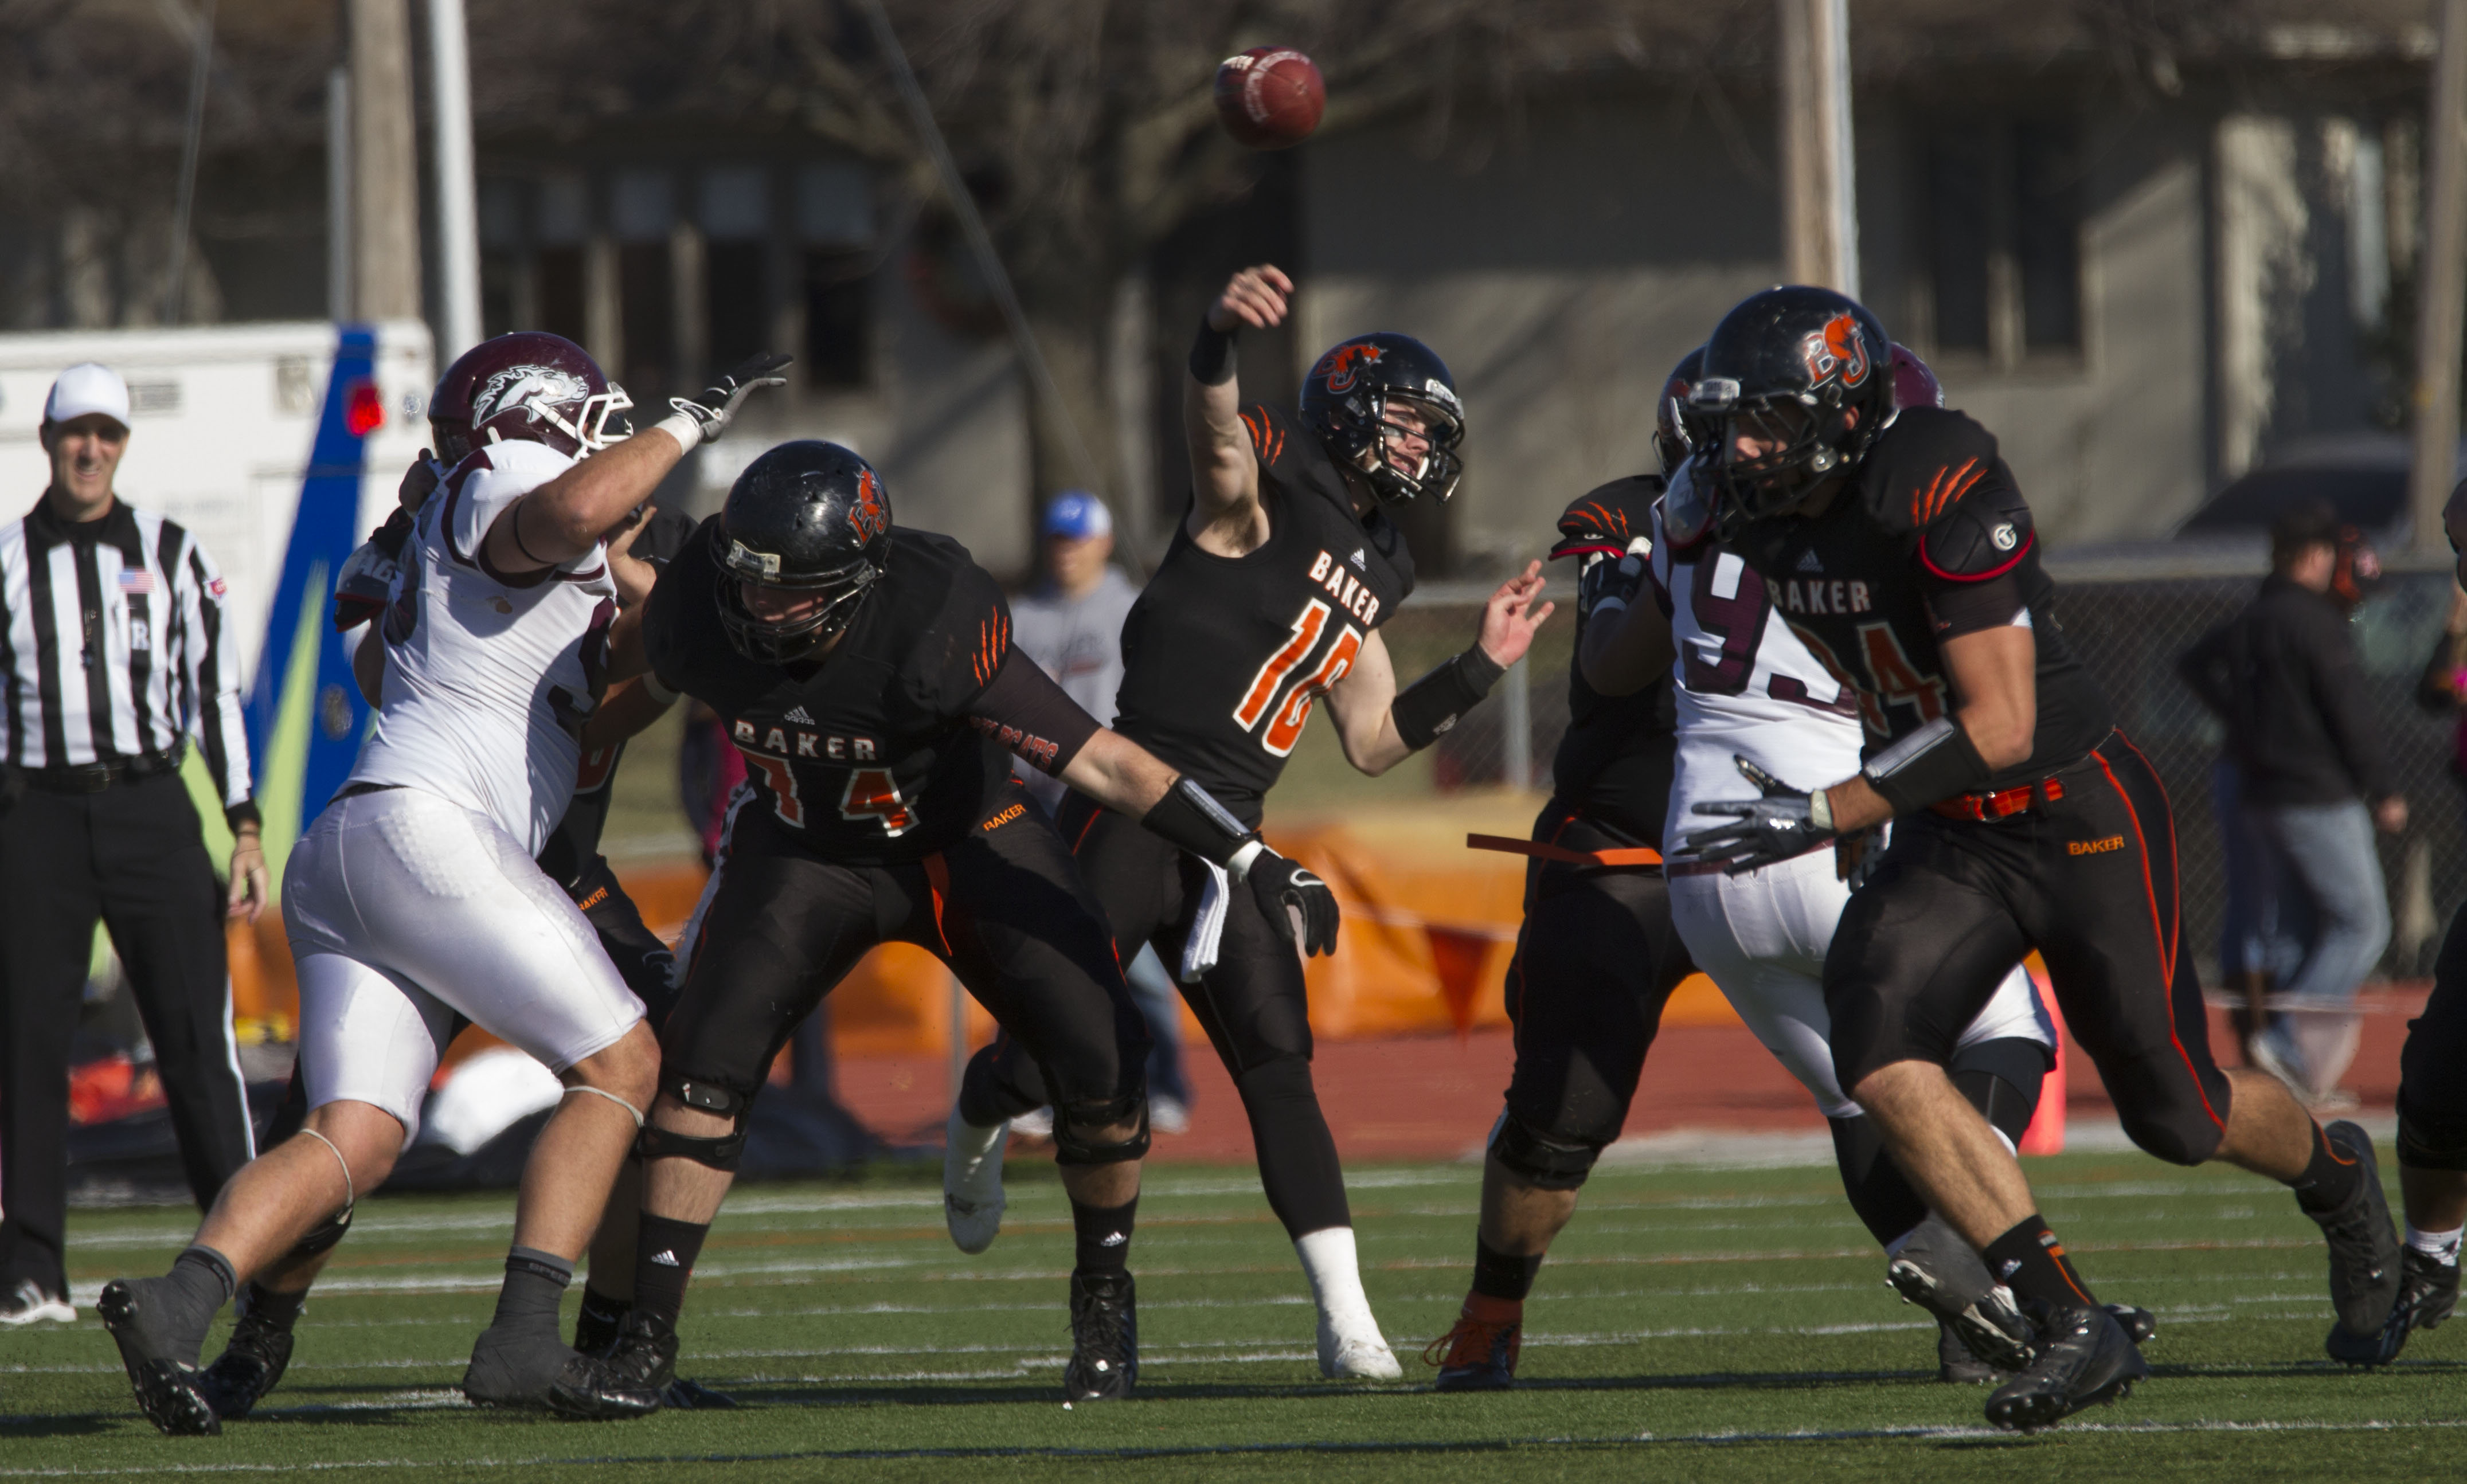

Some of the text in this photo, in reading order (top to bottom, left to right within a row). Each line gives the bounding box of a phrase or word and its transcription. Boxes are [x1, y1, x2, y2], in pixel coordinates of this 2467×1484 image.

[1308, 549, 1381, 626] BAKER
[1766, 578, 1872, 614] BAKER
[131, 618, 150, 651] R
[784, 714, 815, 726] adidas
[734, 719, 877, 761] BAKER
[733, 742, 921, 838] 74
[2067, 835, 2125, 856] BAKER
